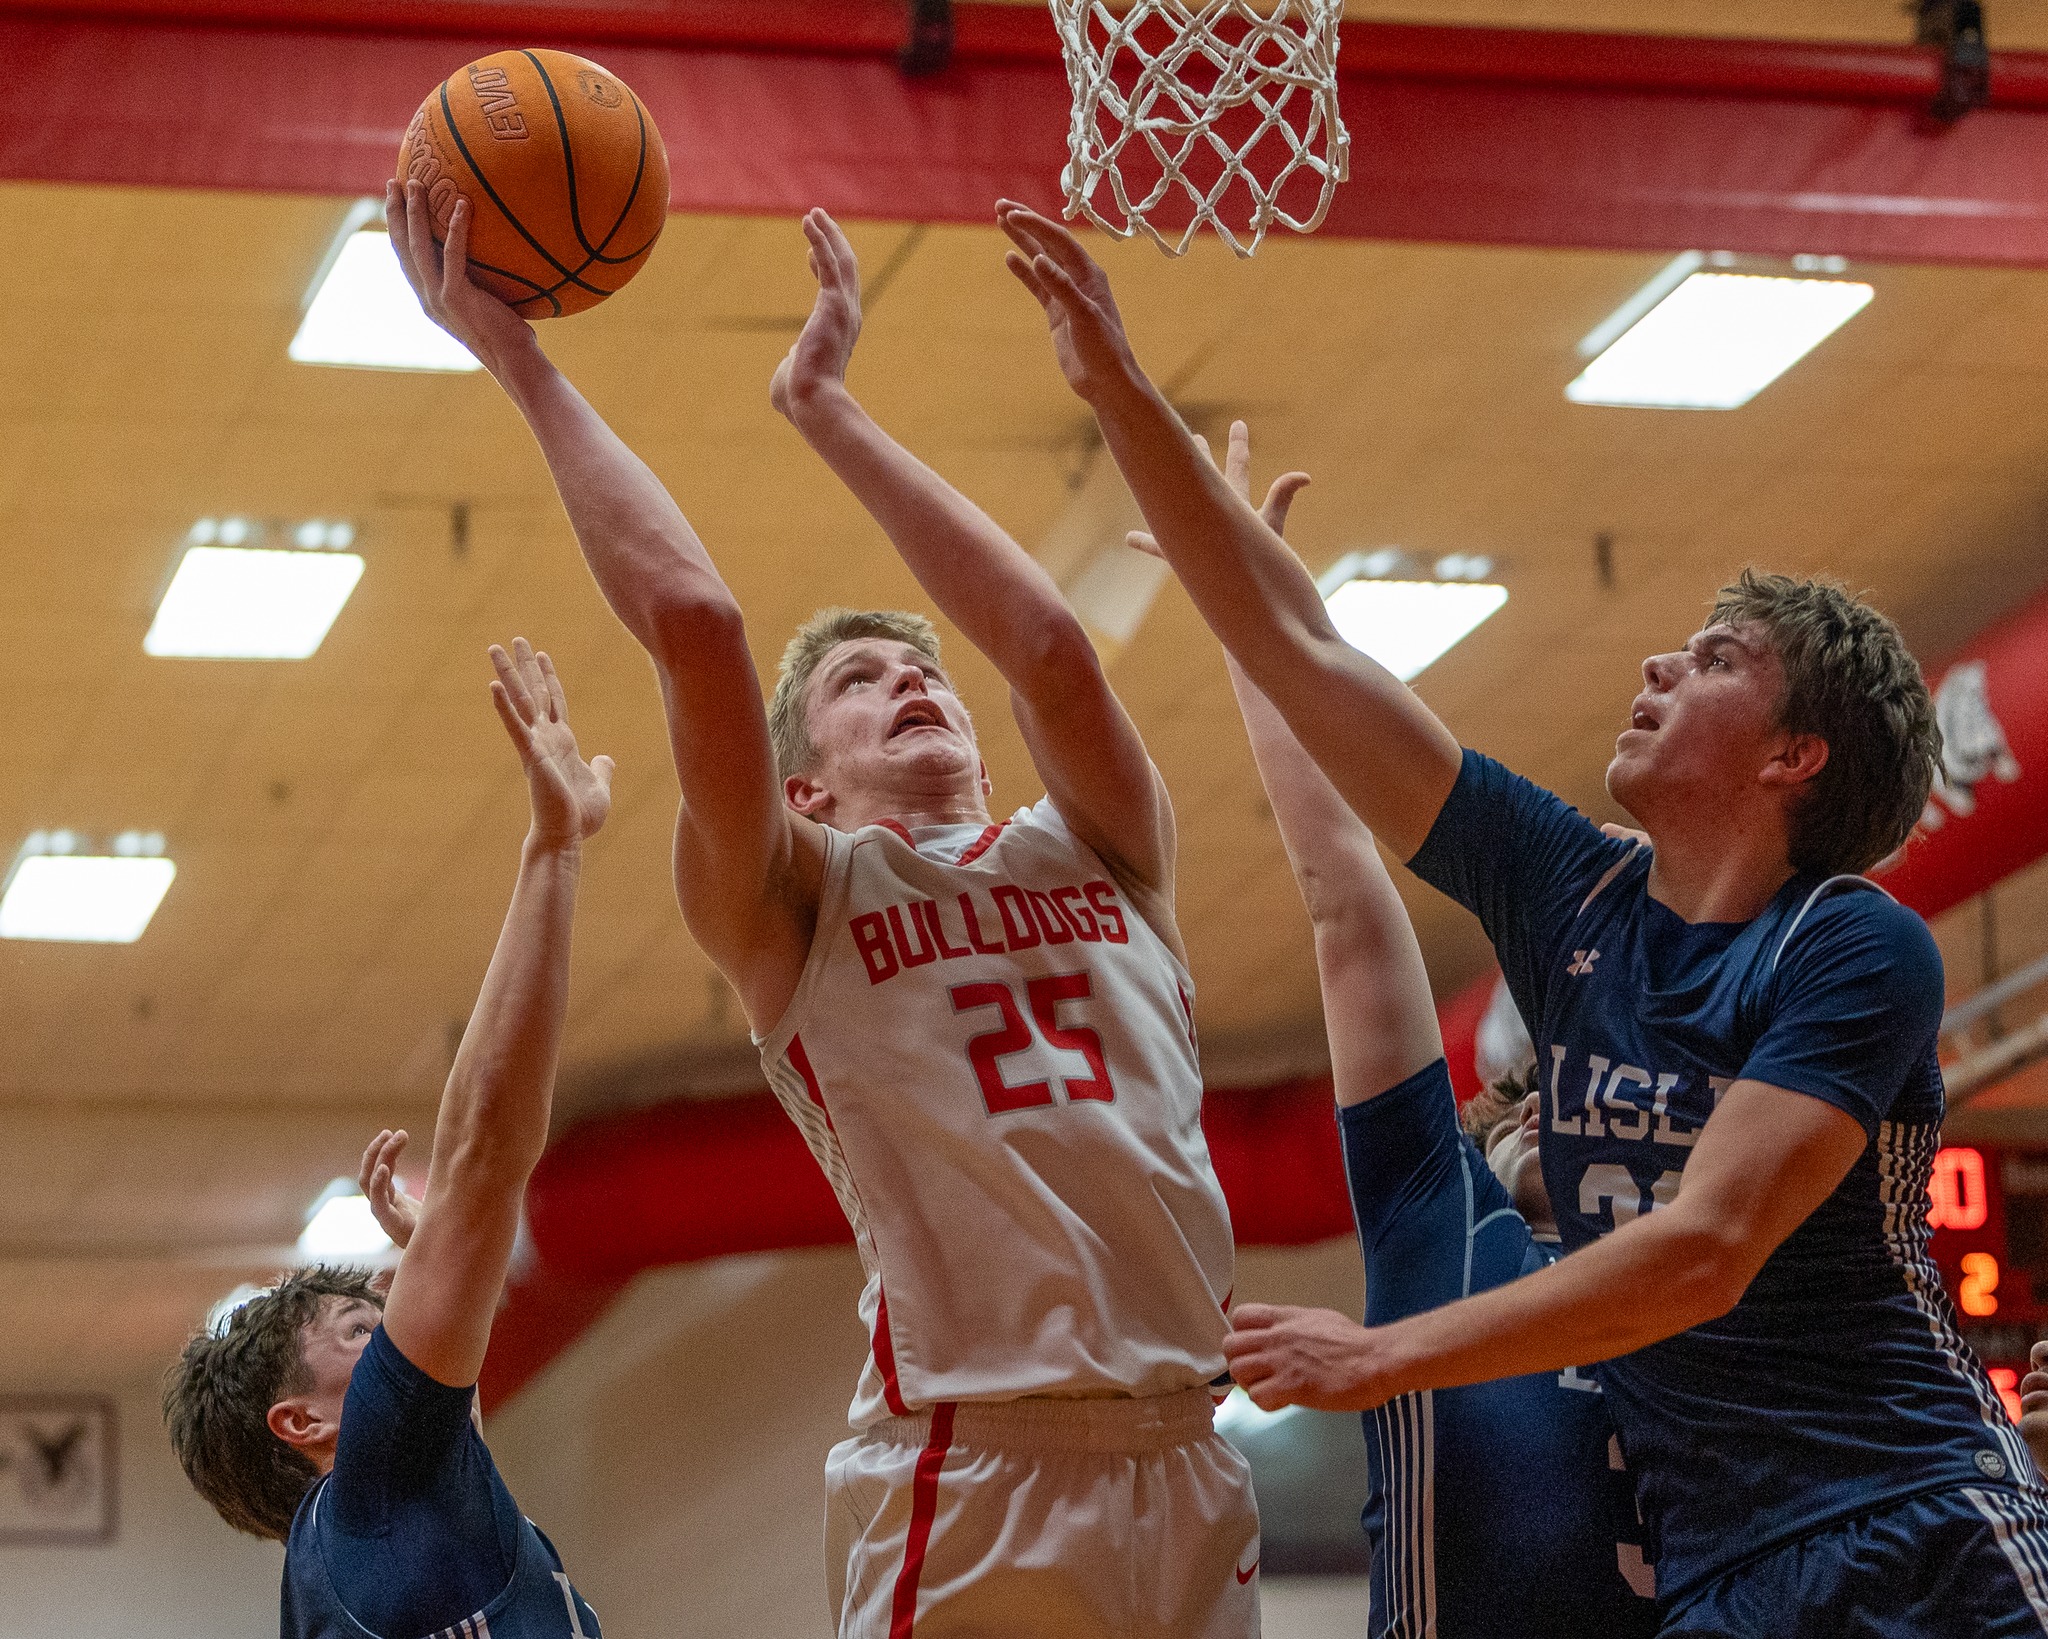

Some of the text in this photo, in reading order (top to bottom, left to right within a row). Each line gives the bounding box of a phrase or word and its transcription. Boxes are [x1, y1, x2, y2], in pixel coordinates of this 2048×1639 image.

[469, 67, 530, 141] EVO
[849, 880, 1130, 986] BULLDOGS
[945, 968, 1117, 1119] 25
[1550, 1044, 1736, 1147] LISL
[1960, 1252, 1999, 1316] 2
